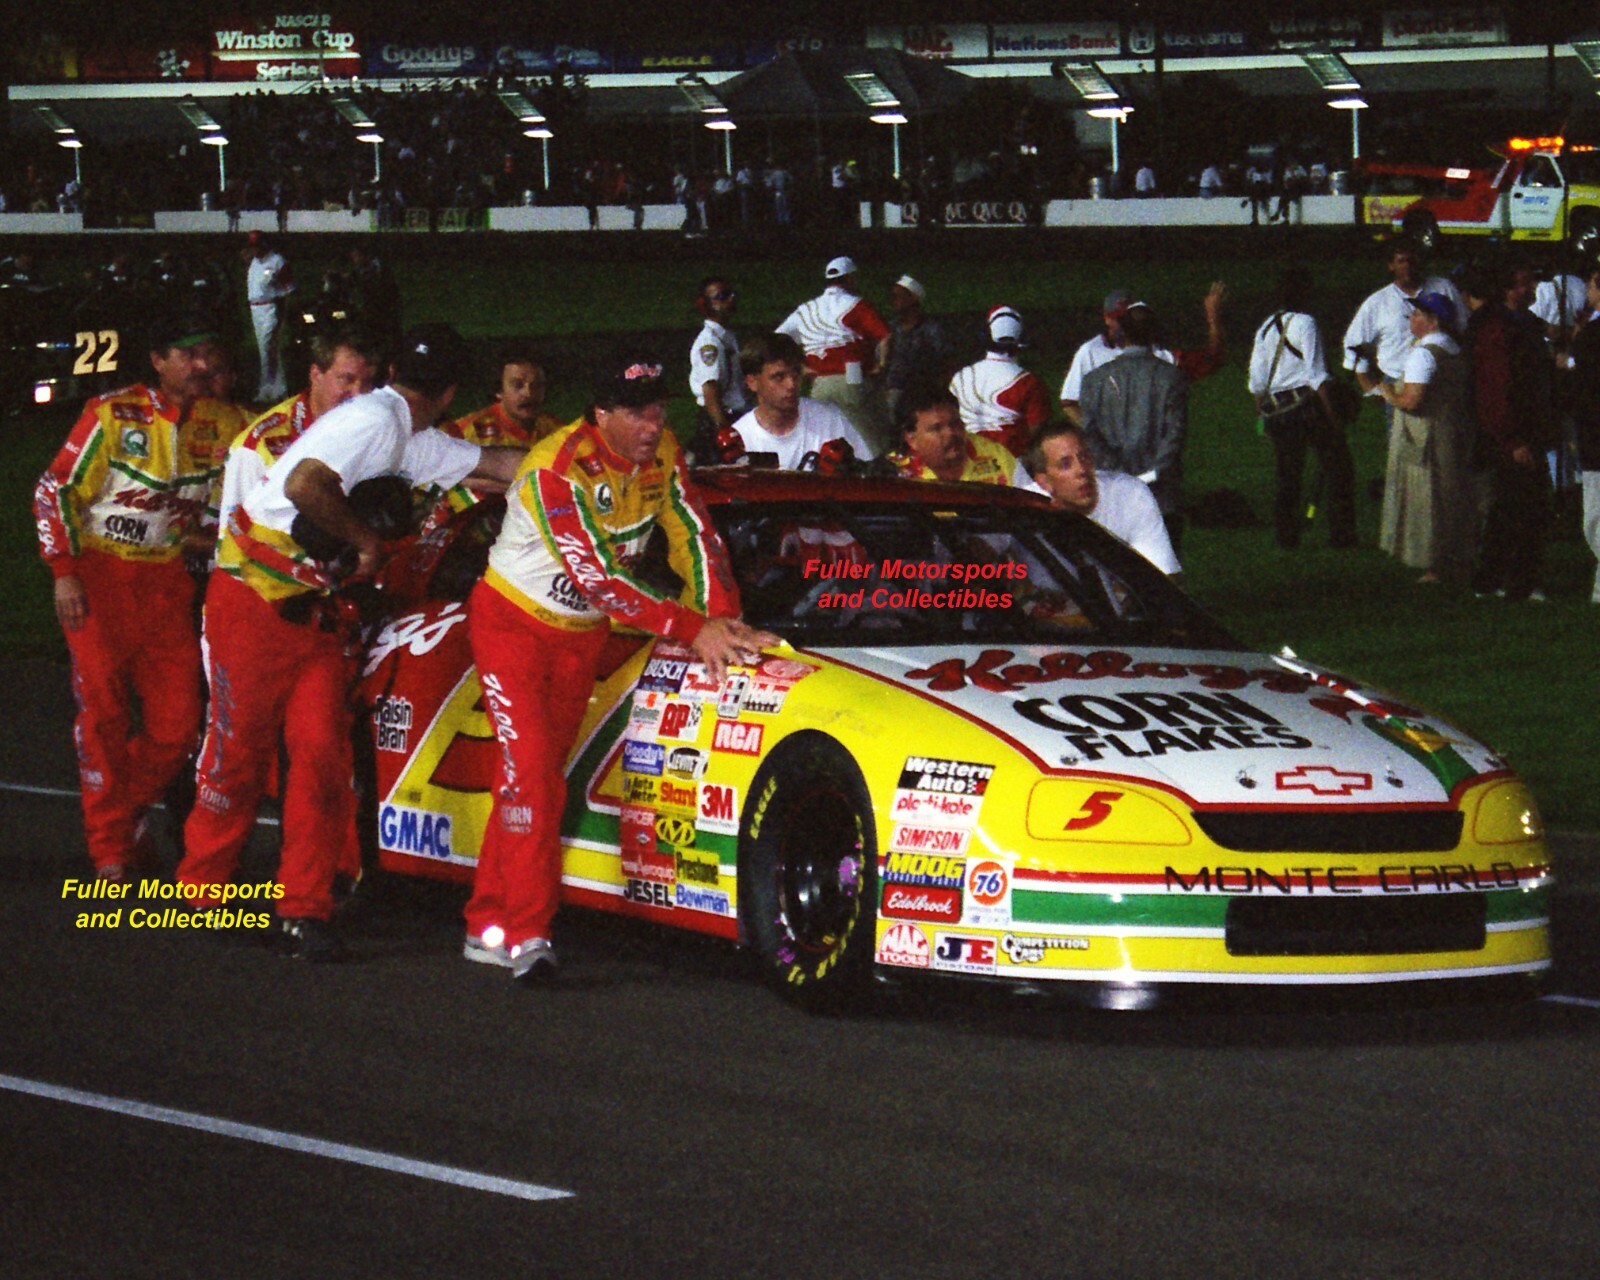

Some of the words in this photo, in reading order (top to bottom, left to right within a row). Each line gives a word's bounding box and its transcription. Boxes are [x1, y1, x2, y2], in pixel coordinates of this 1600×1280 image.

[275, 14, 332, 28] NASCAR
[215, 30, 301, 50] Winston
[312, 29, 355, 51] Cup
[995, 34, 1117, 51] NationsBank
[256, 62, 320, 81] Series
[642, 55, 714, 67] EAGLE
[73, 330, 119, 375] 22
[105, 514, 148, 542] CORN
[644, 659, 688, 680] BUSCH
[659, 703, 690, 738] AP
[1013, 692, 1283, 734] CORN
[376, 723, 407, 753] Bran
[715, 723, 761, 753] RCA
[1065, 726, 1312, 761] FLAKES
[905, 757, 994, 779] Western
[917, 774, 966, 793] Auto
[701, 784, 733, 820] 3M
[1063, 791, 1125, 831] 5
[380, 806, 452, 857] GMAC
[897, 827, 963, 850] SIMPSON
[886, 853, 966, 878] MOOG
[1165, 866, 1362, 894] MONTE
[1379, 862, 1519, 893] CARLO
[624, 879, 673, 908] JESEL
[976, 873, 1001, 894] 76
[676, 883, 730, 914] Bowman
[887, 891, 953, 915] Edelbrock
[881, 952, 928, 966] TOOLS
[937, 936, 995, 965] JE
